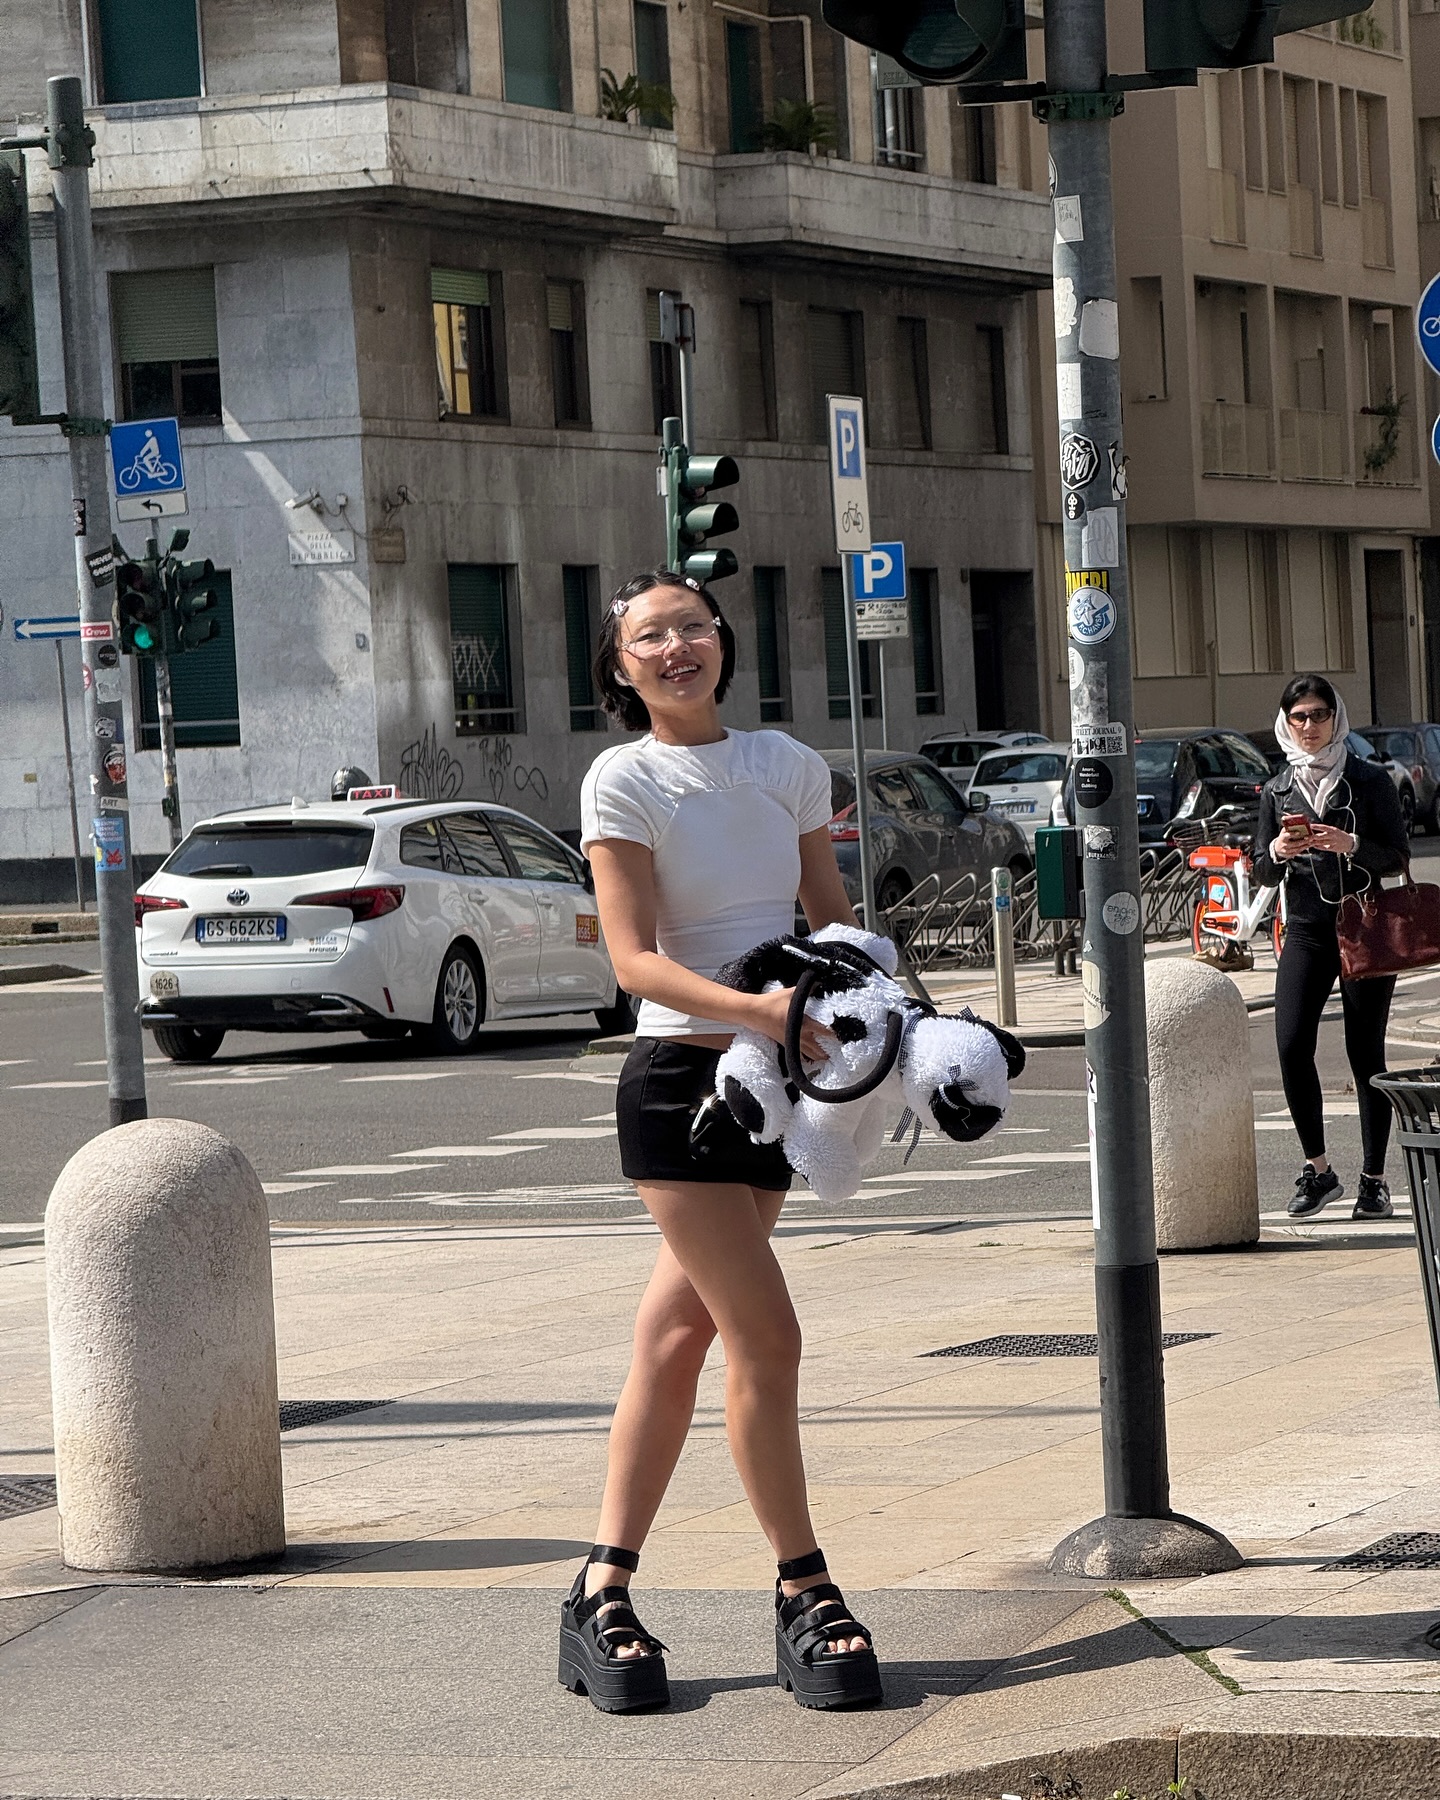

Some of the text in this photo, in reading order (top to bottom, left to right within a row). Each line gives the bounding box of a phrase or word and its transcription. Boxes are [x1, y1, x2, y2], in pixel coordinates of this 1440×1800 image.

[840, 418, 855, 470] P
[291, 551, 353, 560] REPUBBLICA
[863, 551, 893, 594] P
[1092, 727, 1117, 735] JOURNAL
[353, 788, 390, 799] TAXI
[206, 919, 275, 937] GS 662KS
[155, 978, 173, 990] 1626
